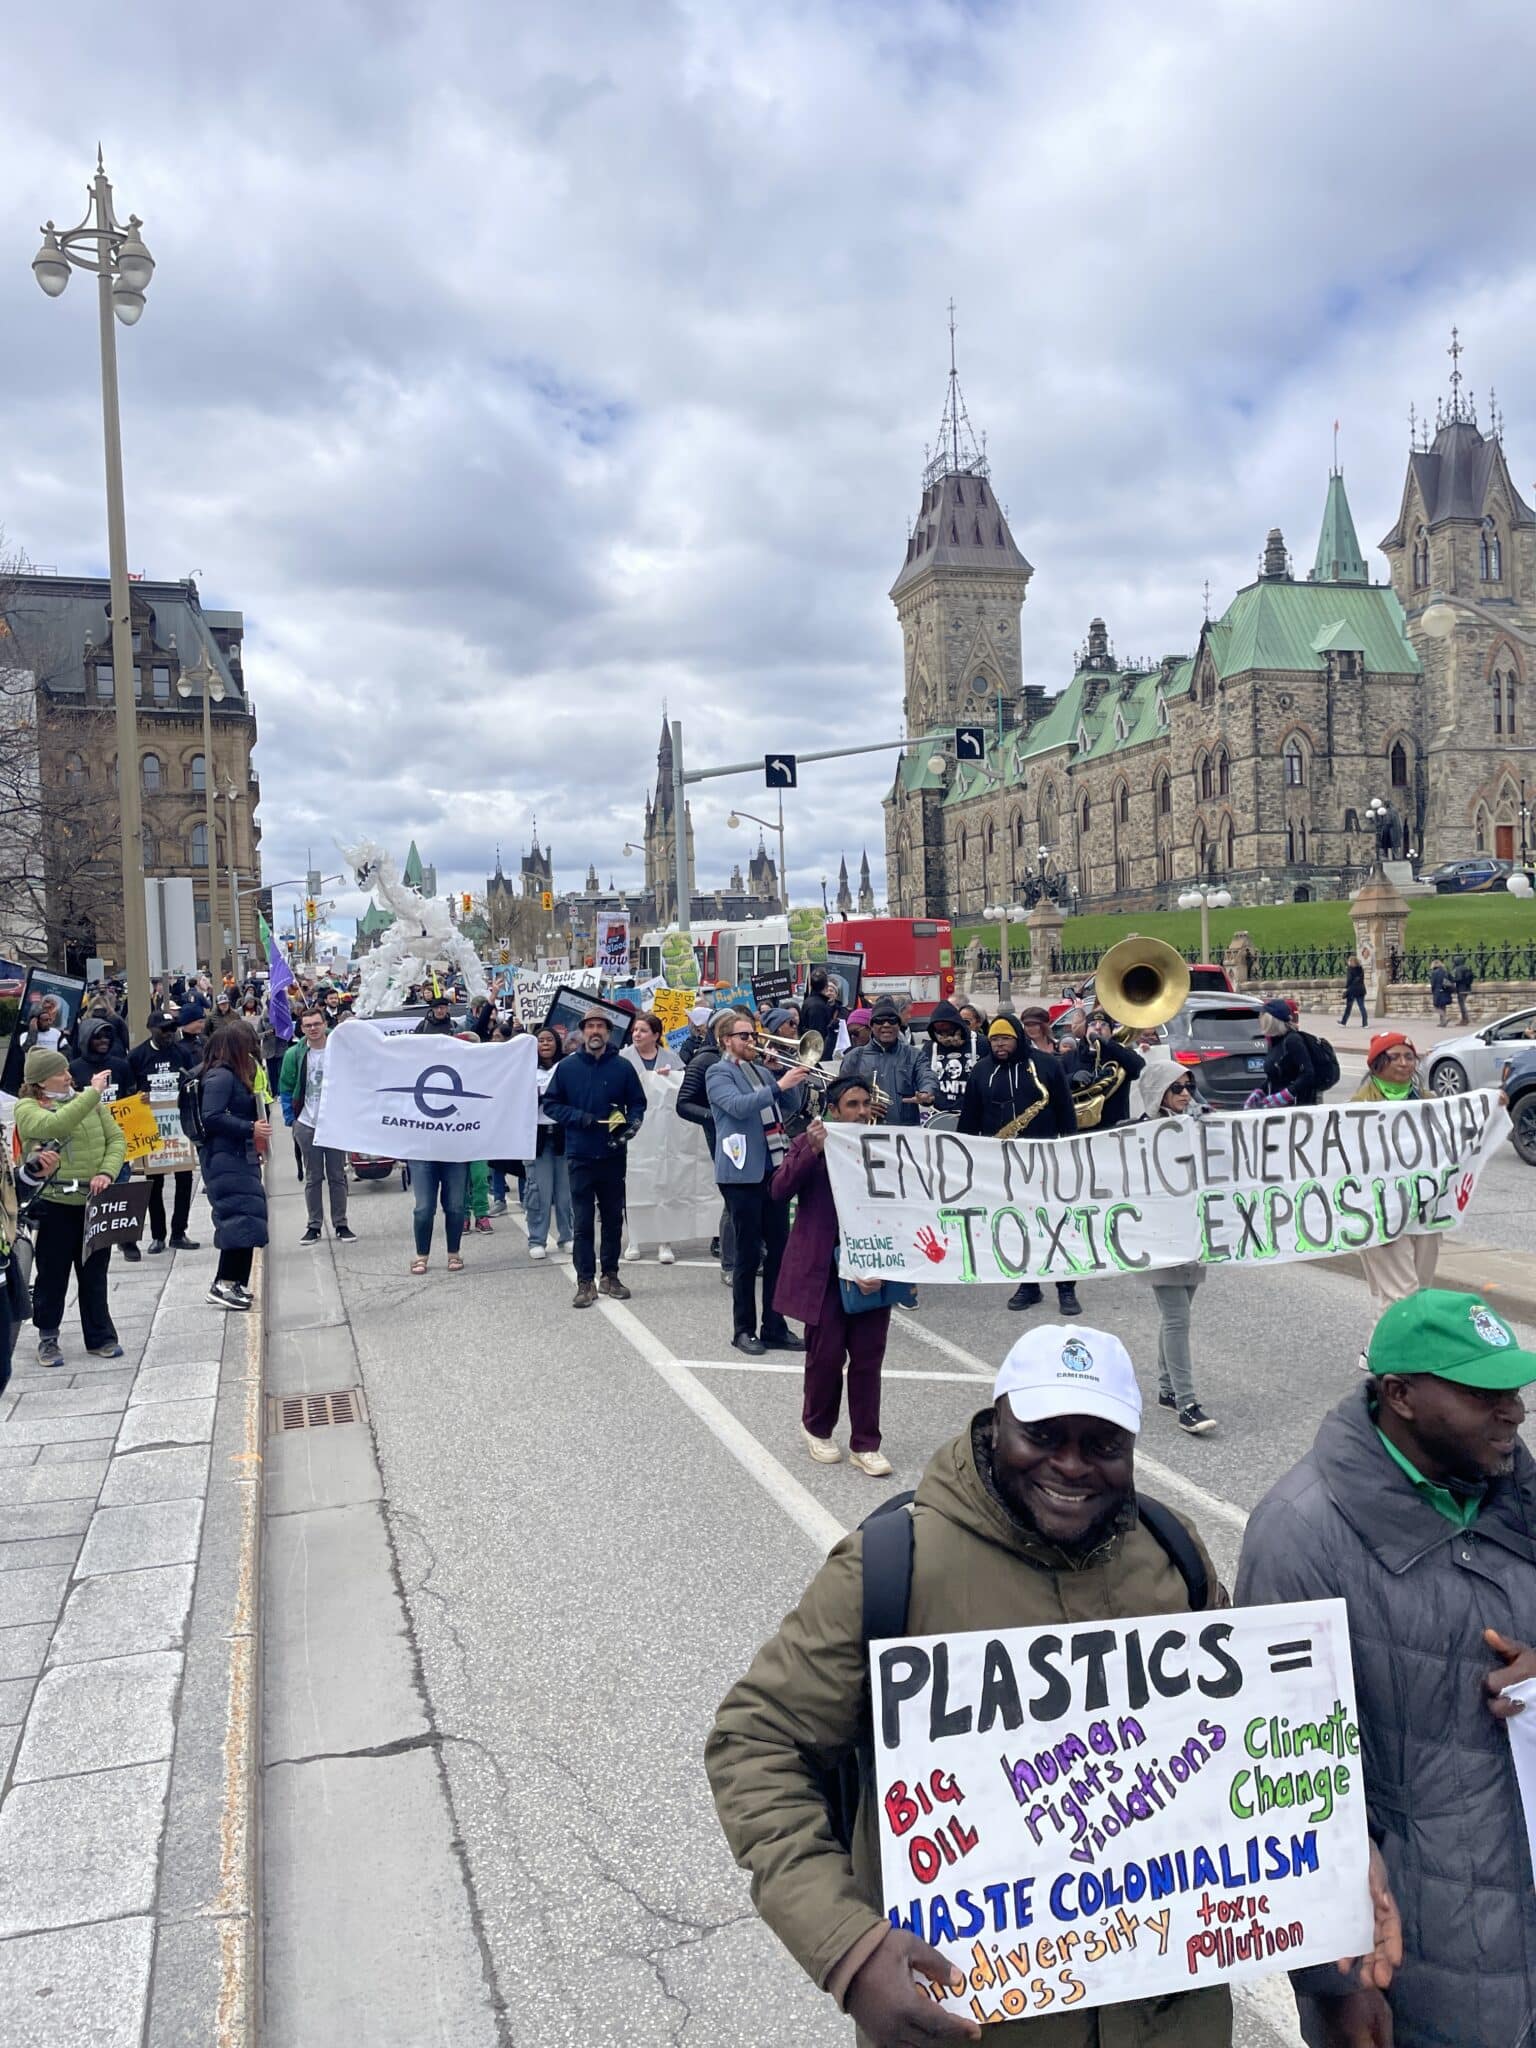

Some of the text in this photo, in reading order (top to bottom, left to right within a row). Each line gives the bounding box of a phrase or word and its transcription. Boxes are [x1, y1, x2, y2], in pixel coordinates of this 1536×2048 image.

[110, 1104, 132, 1121] Fin
[381, 1115, 481, 1132] EARTHDAY.ORG
[860, 1133, 974, 1204] END
[101, 1201, 128, 1214] THE
[111, 1216, 138, 1230] ERA
[937, 1164, 1460, 1283] TOXIC EXPOSURE
[879, 1622, 1243, 1750] PLASTICS
[1000, 1716, 1147, 1808] human
[1244, 1699, 1360, 1759] Climate
[885, 1768, 966, 1837] BIG
[1024, 1760, 1124, 1847] rights
[1070, 1719, 1227, 1864] violations
[1229, 1764, 1351, 1823] Change
[909, 1815, 980, 1884] OIL
[888, 1830, 1321, 1947] WASTE COLONIALISM
[1197, 1892, 1271, 1927] toxic
[1186, 1918, 1305, 1975] pollution
